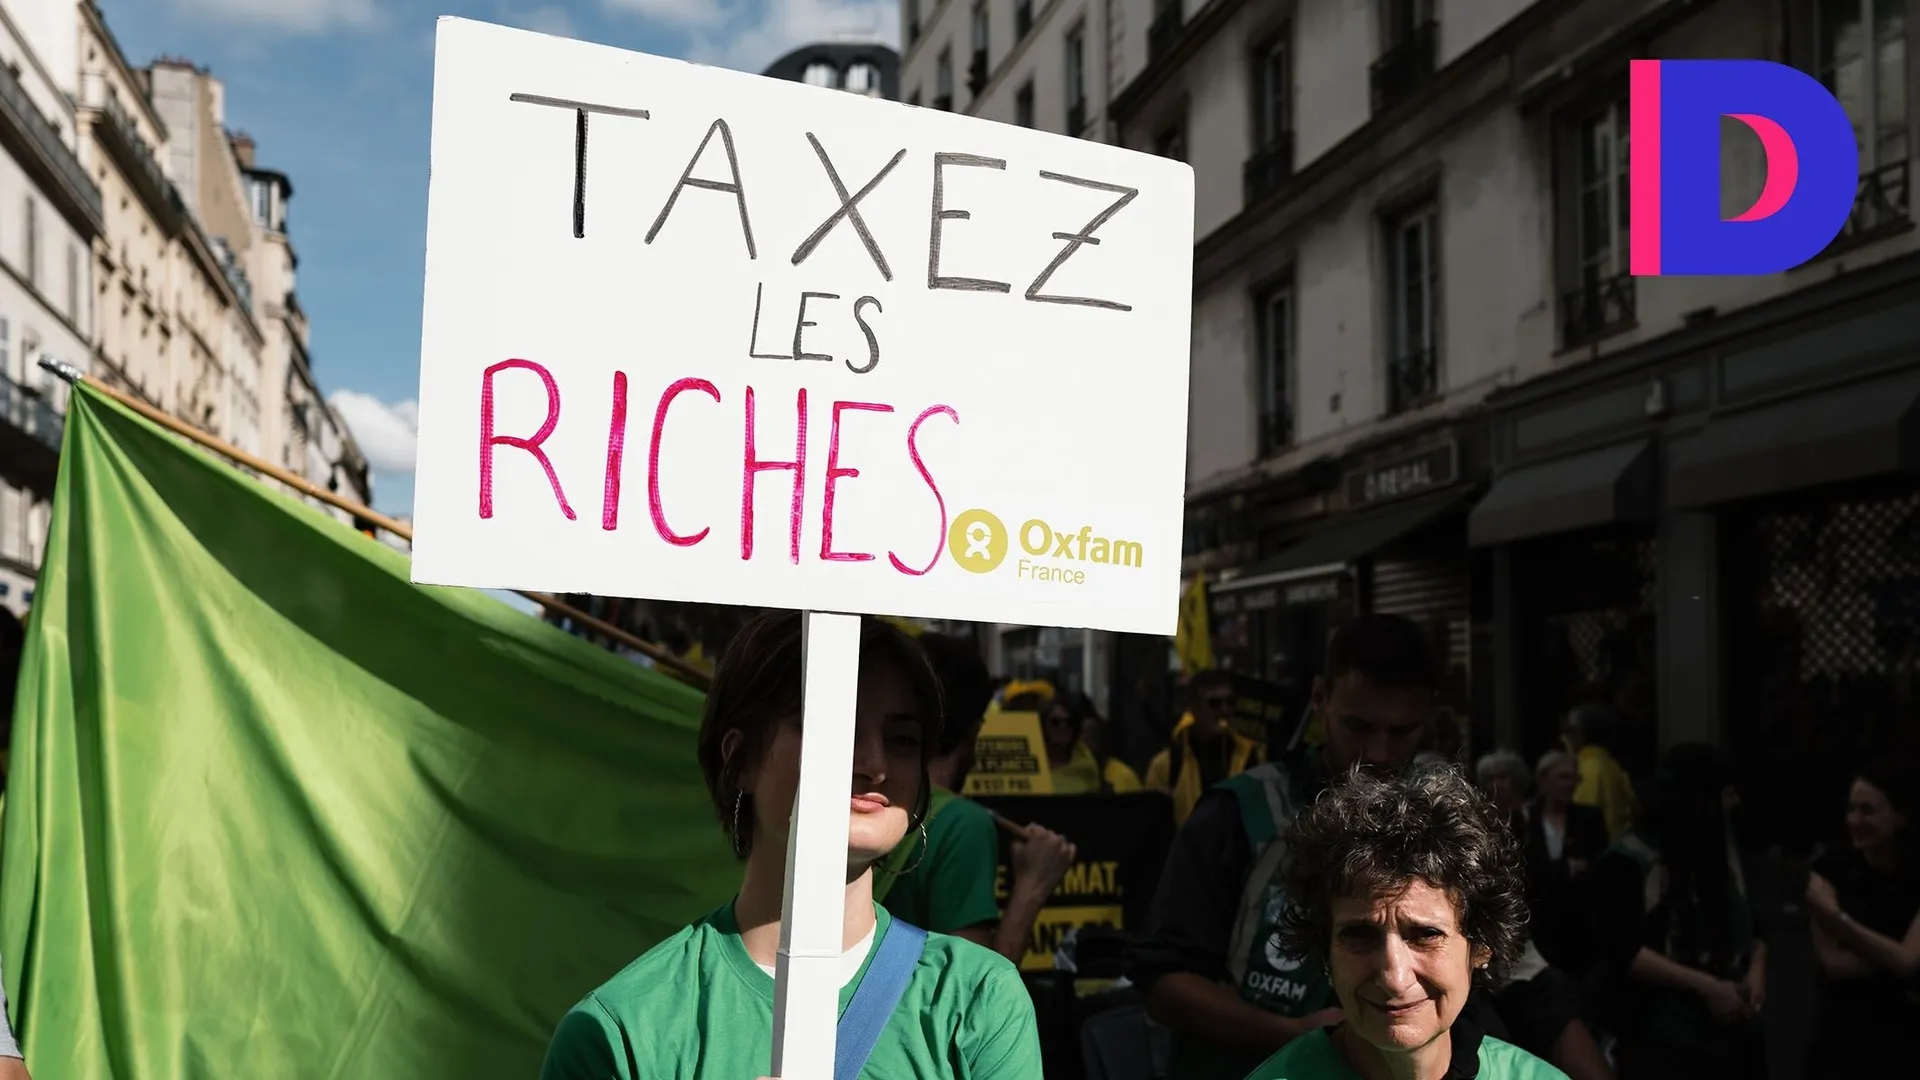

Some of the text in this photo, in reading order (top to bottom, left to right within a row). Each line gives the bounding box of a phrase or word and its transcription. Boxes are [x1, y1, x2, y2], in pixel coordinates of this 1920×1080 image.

[509, 93, 1139, 312] TAXEZ
[748, 282, 882, 375] LES
[479, 358, 960, 577] RICHES
[1019, 518, 1143, 568] Oxfam
[1018, 559, 1085, 585] France
[1053, 859, 1124, 897] MAT,
[1247, 970, 1308, 1003] OXFAM
